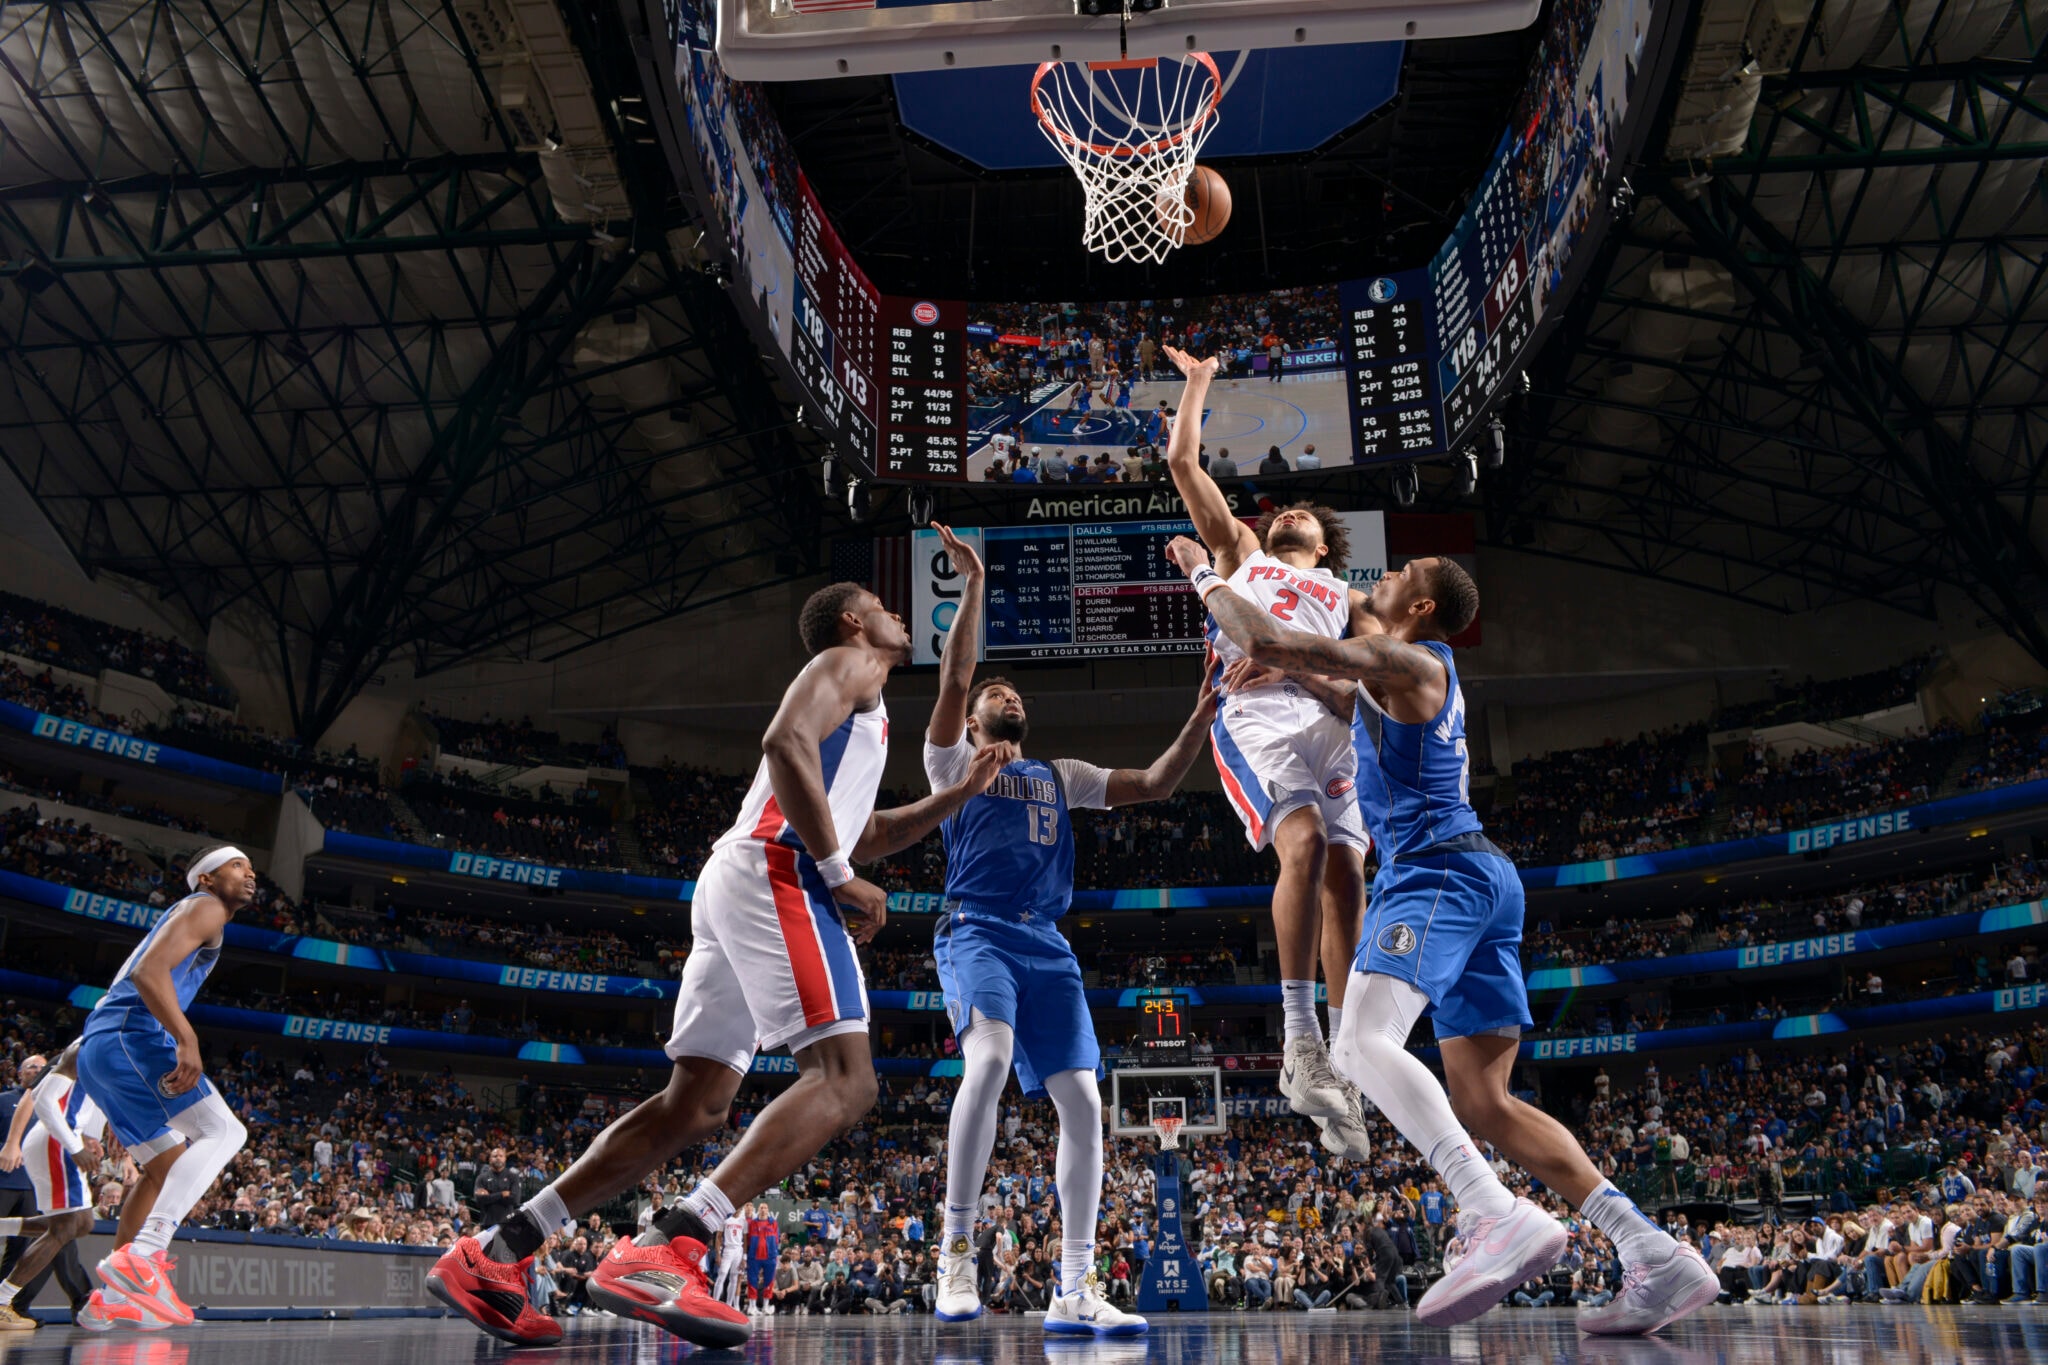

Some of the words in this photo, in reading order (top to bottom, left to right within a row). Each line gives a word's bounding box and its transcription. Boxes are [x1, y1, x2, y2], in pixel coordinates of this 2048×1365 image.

[1354, 310, 1374, 320] REB
[1392, 304, 1405, 313] 44
[1452, 327, 1476, 376] 118
[1495, 258, 1518, 312] 113
[893, 328, 912, 337] REB
[1355, 324, 1368, 333] TO
[1393, 318, 1407, 327] 20
[1356, 336, 1375, 346] BLK
[1398, 331, 1404, 340] 7
[1510, 335, 1520, 354] FLS
[802, 297, 823, 348] 118
[843, 360, 867, 406] 113
[892, 354, 911, 363] BLK
[1357, 350, 1375, 359] STL
[1399, 344, 1406, 352] 9
[1476, 334, 1500, 388] 24.7
[892, 368, 909, 376] STL
[1359, 370, 1372, 379] FG
[1391, 363, 1418, 374] 41/79
[820, 367, 843, 414] 24.7
[892, 387, 904, 396] FG
[924, 390, 952, 398] 44/96
[1360, 382, 1382, 392] 3-PT
[1392, 377, 1420, 388] 12/34
[892, 401, 913, 409] 3-PT
[927, 403, 950, 411] 11/31
[1361, 397, 1373, 406] FT
[1392, 390, 1422, 401] 24/33
[851, 412, 860, 430] TOL
[925, 416, 951, 424] 14/19
[1363, 417, 1377, 426] FG
[1399, 410, 1429, 421] 51.9%
[1454, 415, 1464, 431] FLS
[1364, 430, 1387, 440] 3-PT
[1400, 423, 1431, 435] 35.3%
[851, 433, 860, 449] FLS
[864, 447, 868, 457] 5
[891, 434, 903, 442] FG
[927, 437, 957, 446] 45.8%
[1366, 444, 1377, 453] FT
[1402, 437, 1432, 448] 72.7%
[927, 450, 957, 459] 35.5%
[890, 461, 902, 469] FT
[929, 464, 957, 472] 73.7%
[1027, 494, 1142, 518] American
[1077, 527, 1112, 535] DALLAS
[1350, 568, 1382, 581] TXU
[1079, 587, 1119, 596] DETROIT
[1247, 566, 1340, 612] PISTONS
[1270, 588, 1299, 621] 2
[38, 714, 160, 764] DEFENSE
[985, 772, 1056, 805] DALLAS
[1027, 804, 1058, 846] 13
[1794, 811, 1910, 852] DEFENSE
[456, 855, 562, 887] DEFENSE
[70, 888, 164, 928] DEFENS
[1744, 932, 1856, 966] DEFENSE
[505, 966, 608, 993] DEFENSE
[1145, 1000, 1173, 1013] 24.3
[289, 1017, 392, 1045] DEFENSE
[1157, 1013, 1180, 1036] 17
[1539, 1034, 1638, 1057] DEFENSE
[1224, 1100, 1259, 1115] GET
[1159, 1241, 1181, 1254] Kroger
[189, 1254, 277, 1296] NEXEN
[284, 1260, 335, 1297] TIRE
[1157, 1280, 1188, 1288] RYSE
